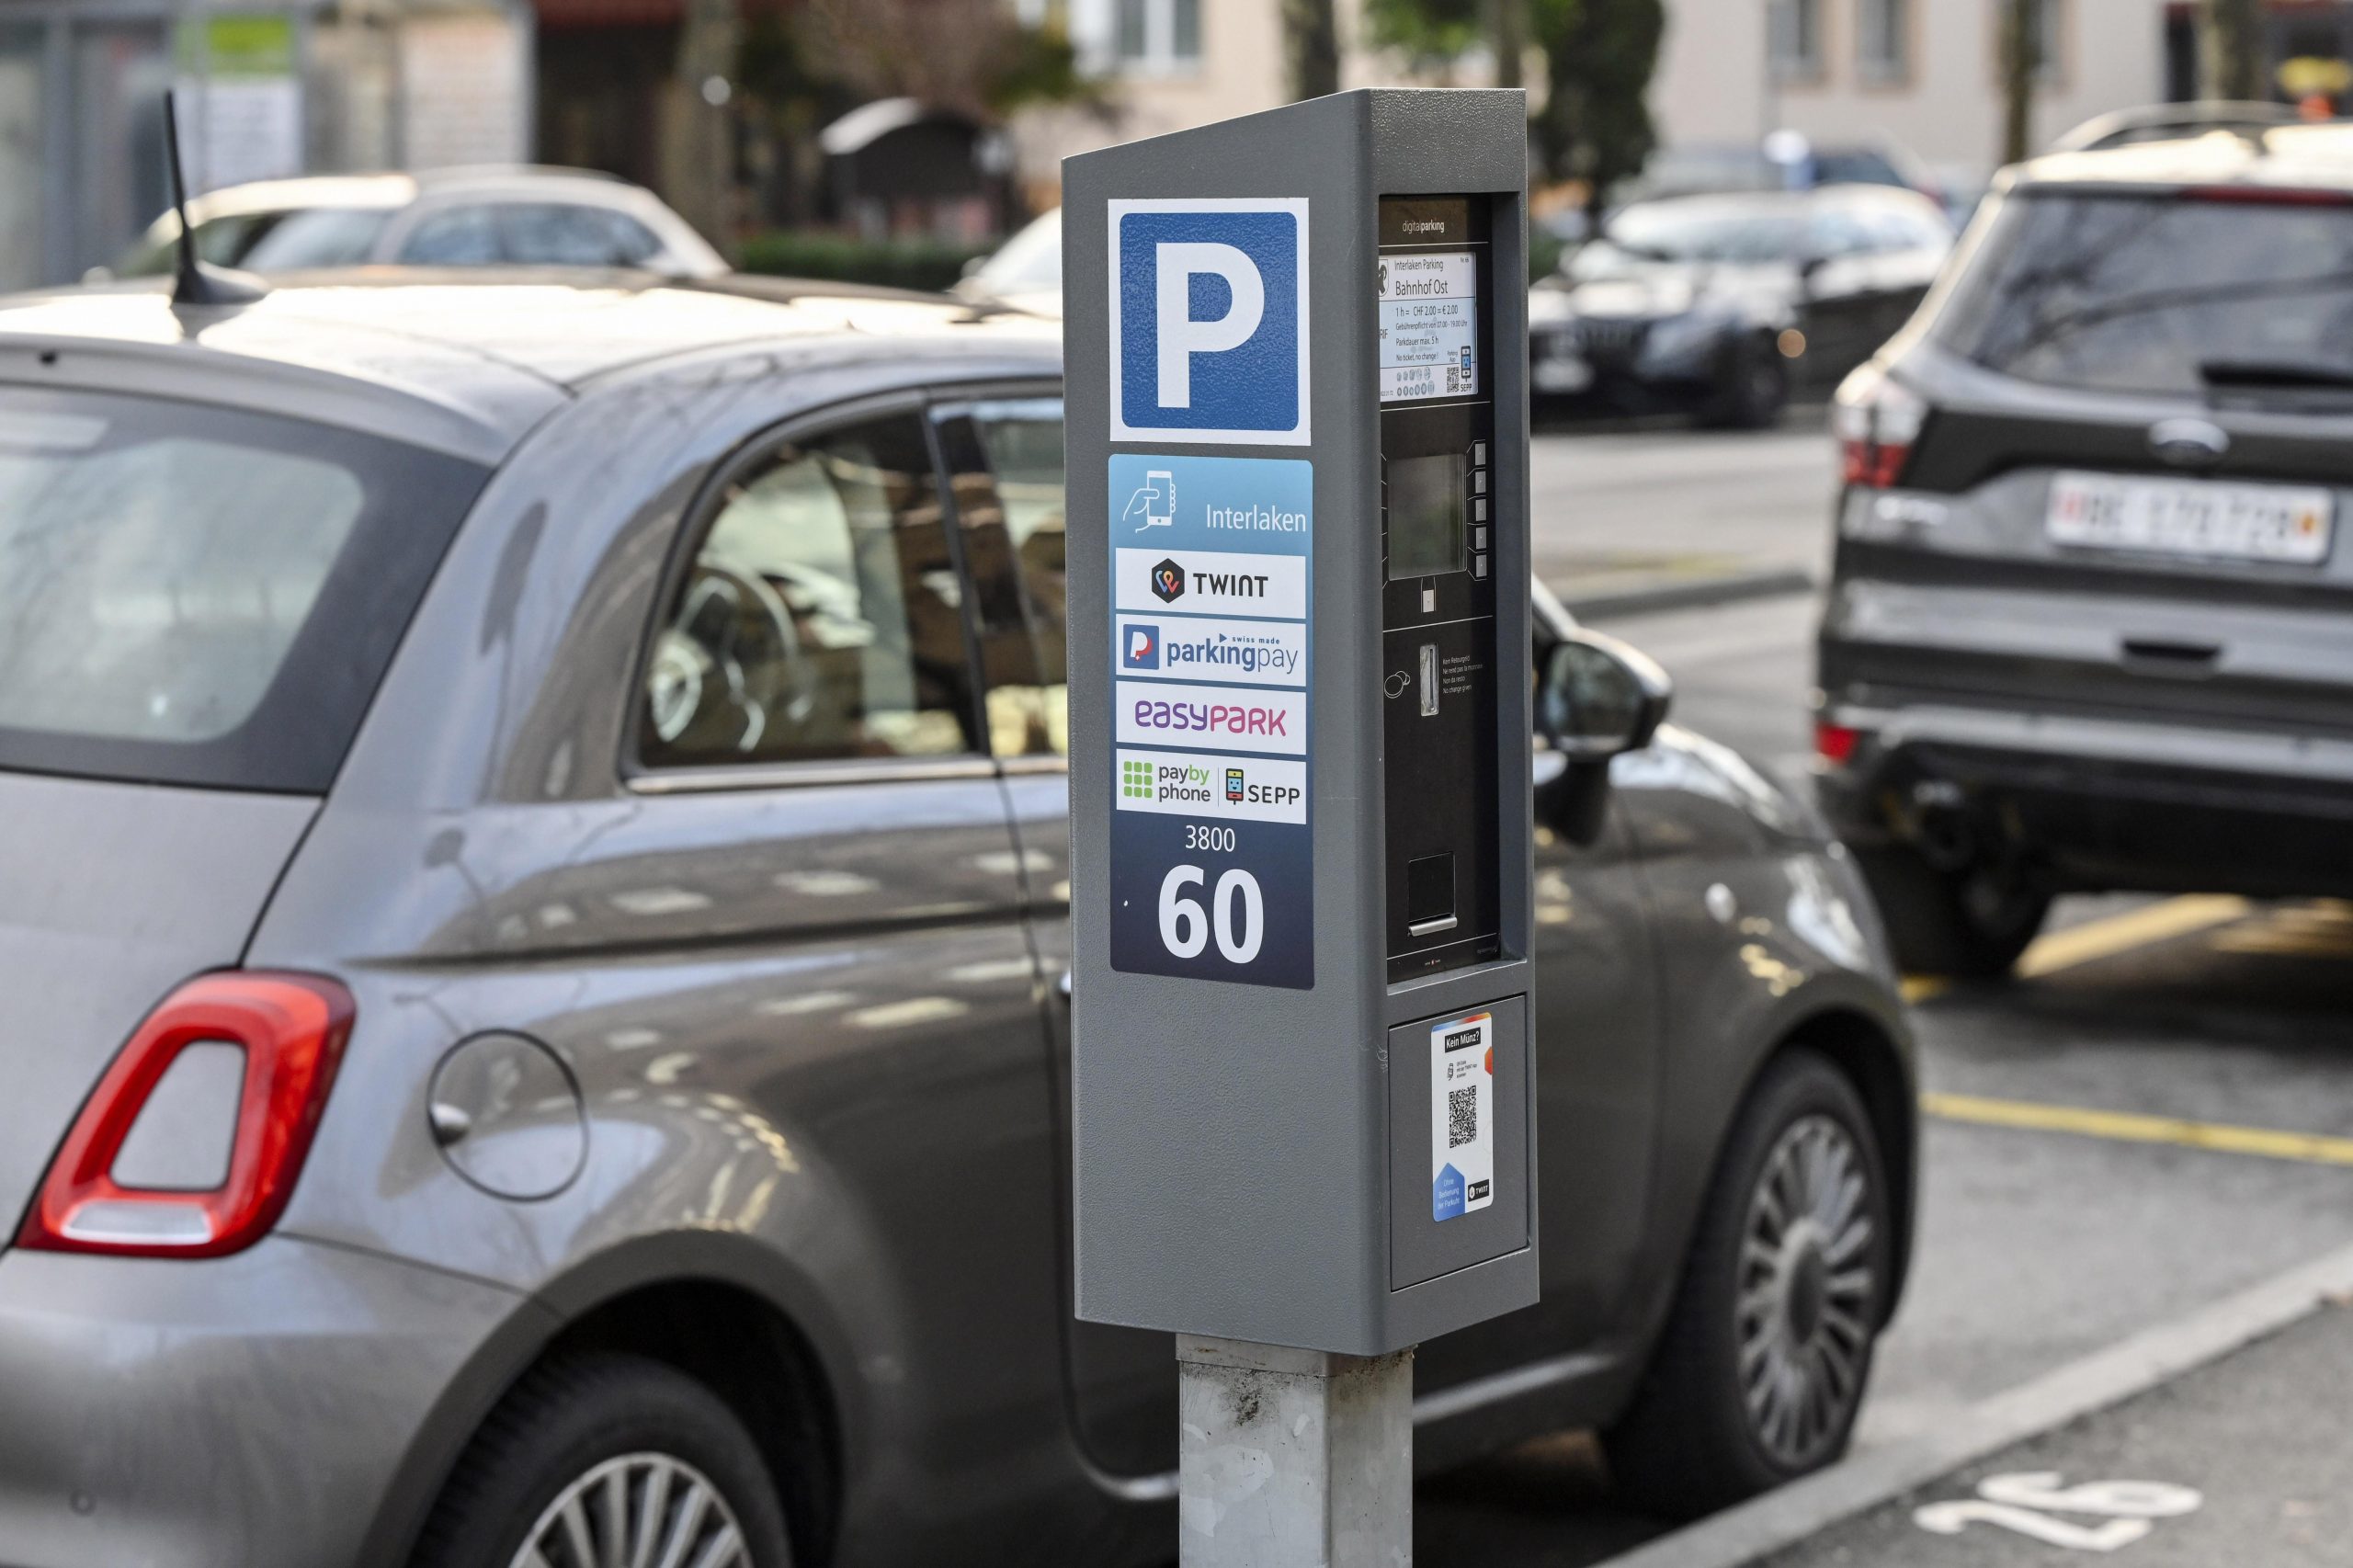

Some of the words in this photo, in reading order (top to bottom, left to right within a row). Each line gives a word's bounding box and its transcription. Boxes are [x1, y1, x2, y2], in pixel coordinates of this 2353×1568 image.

[1403, 219, 1445, 233] digitalparking
[1394, 259, 1422, 271] Interlaken
[1423, 259, 1444, 272] Parking
[1395, 278, 1432, 296] Bahnhof
[1434, 279, 1449, 294] Ost
[1395, 307, 1399, 317] 1
[1400, 307, 1404, 316] h
[1413, 306, 1424, 316] CHF
[1425, 305, 1436, 316] 2.00
[1442, 305, 1447, 314] €
[1447, 304, 1459, 314] 2.00
[1156, 242, 1265, 408] P
[1395, 321, 1428, 331] Gebührenpflicht
[1396, 337, 1419, 347] Parkdauer
[1431, 335, 1435, 345] 5
[1435, 335, 1439, 344] h
[1461, 383, 1472, 392] SEPP
[1207, 504, 1306, 532] Interlaken
[1192, 573, 1268, 597] TWINT
[1232, 635, 1255, 643] swiss
[1258, 637, 1280, 645] made
[1167, 637, 1298, 674] parkingpay
[1158, 764, 1210, 786] payby
[1158, 783, 1211, 802] phone
[1247, 784, 1301, 805] SEPP
[1185, 824, 1236, 853] 3800
[1158, 864, 1264, 964] 60
[1446, 1037, 1459, 1049] Kein
[1460, 1031, 1479, 1045] Münz?
[1476, 1186, 1488, 1194] TWINT
